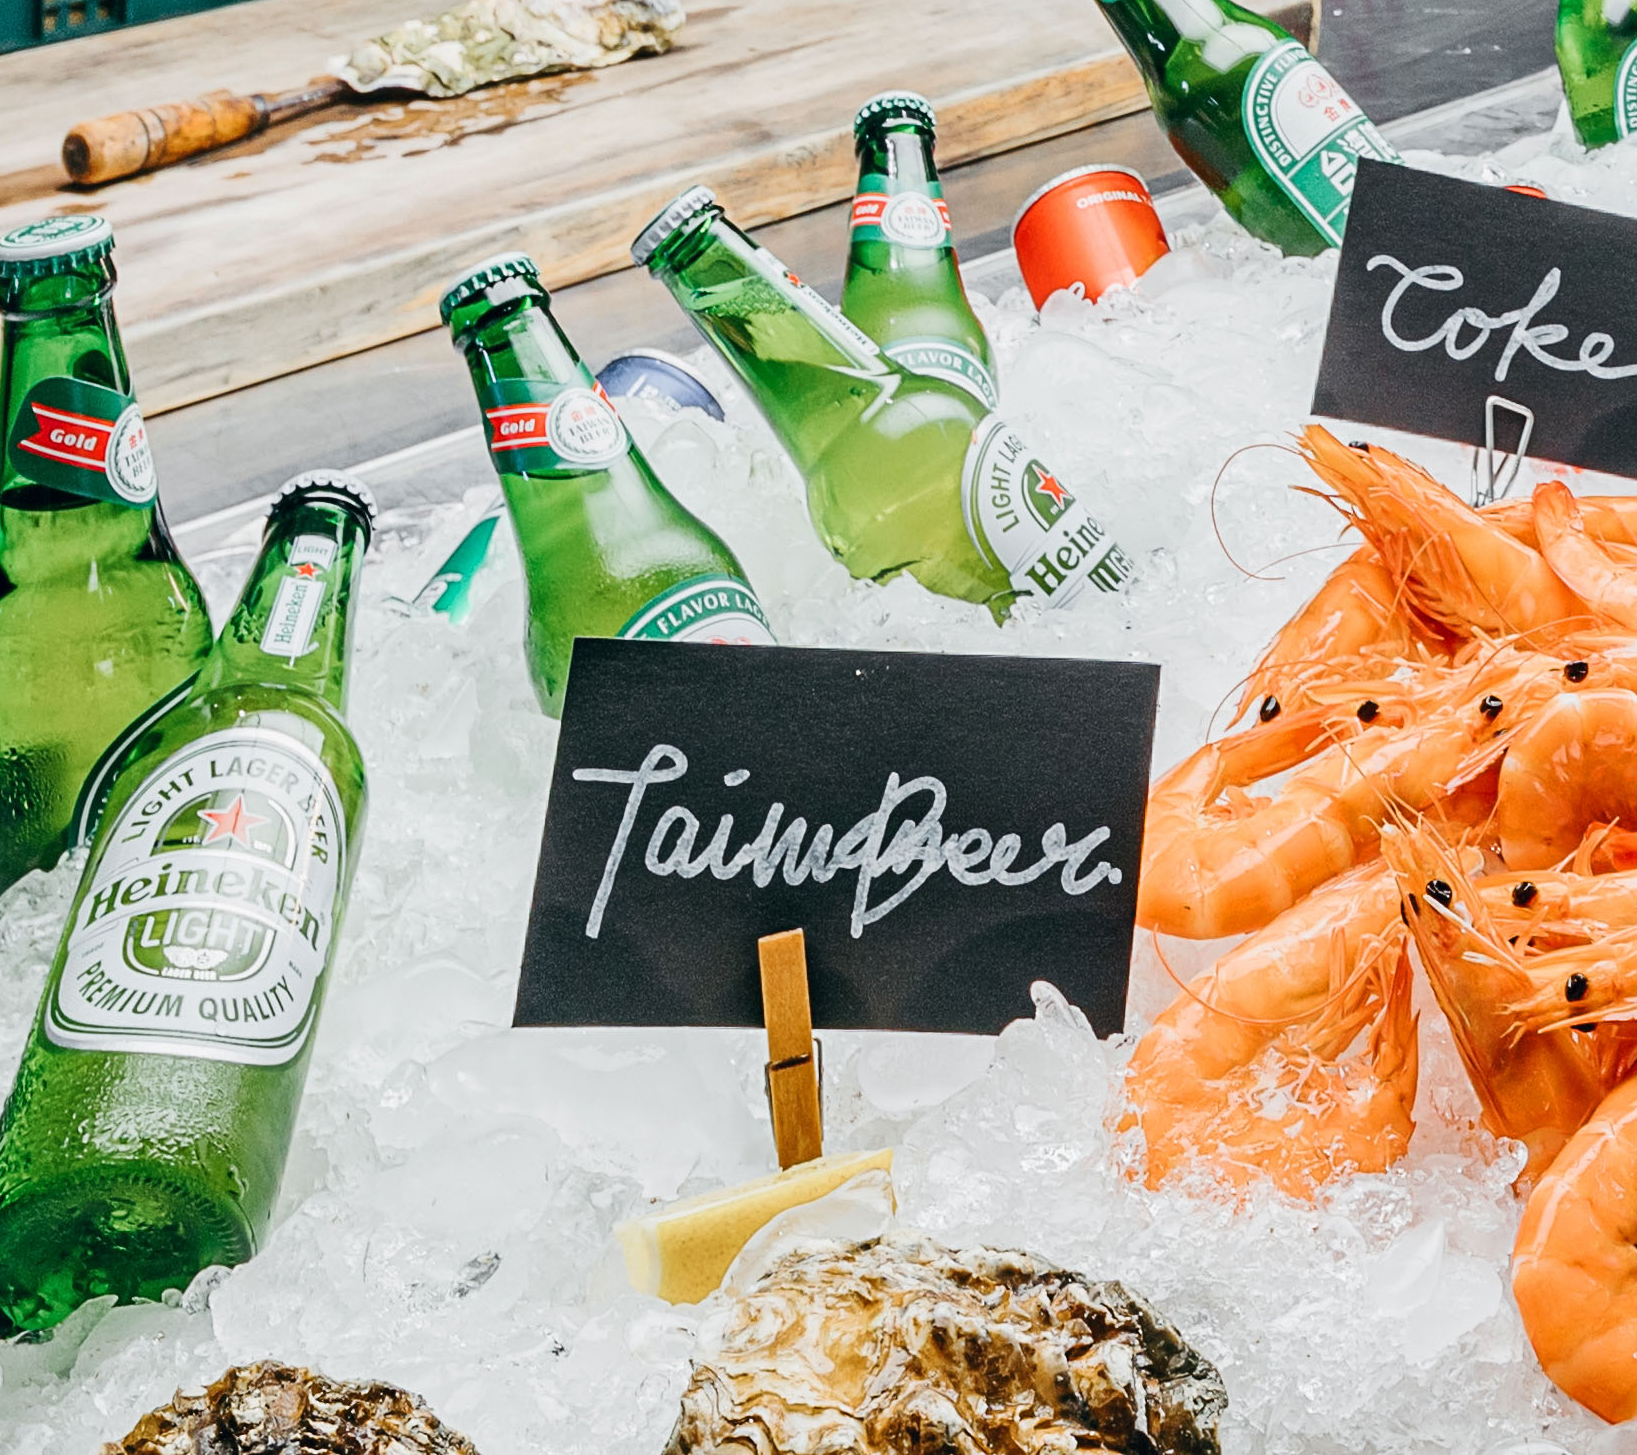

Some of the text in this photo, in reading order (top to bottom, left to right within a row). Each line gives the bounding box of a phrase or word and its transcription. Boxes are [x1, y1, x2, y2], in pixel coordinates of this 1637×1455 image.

[1255, 72, 1293, 167] DISTINCTIVE
[49, 428, 98, 452] Gold
[499, 418, 536, 436] Gold
[990, 463, 1020, 533] LIGHT
[274, 582, 309, 645] Heineken
[657, 592, 766, 635] FLAVOR LAG
[121, 767, 195, 843] LIGHT
[210, 757, 300, 793] LAGER
[82, 863, 322, 952] Heineken
[140, 911, 263, 955] LIGHT
[76, 960, 296, 1023] PREMIUM QUALITY
